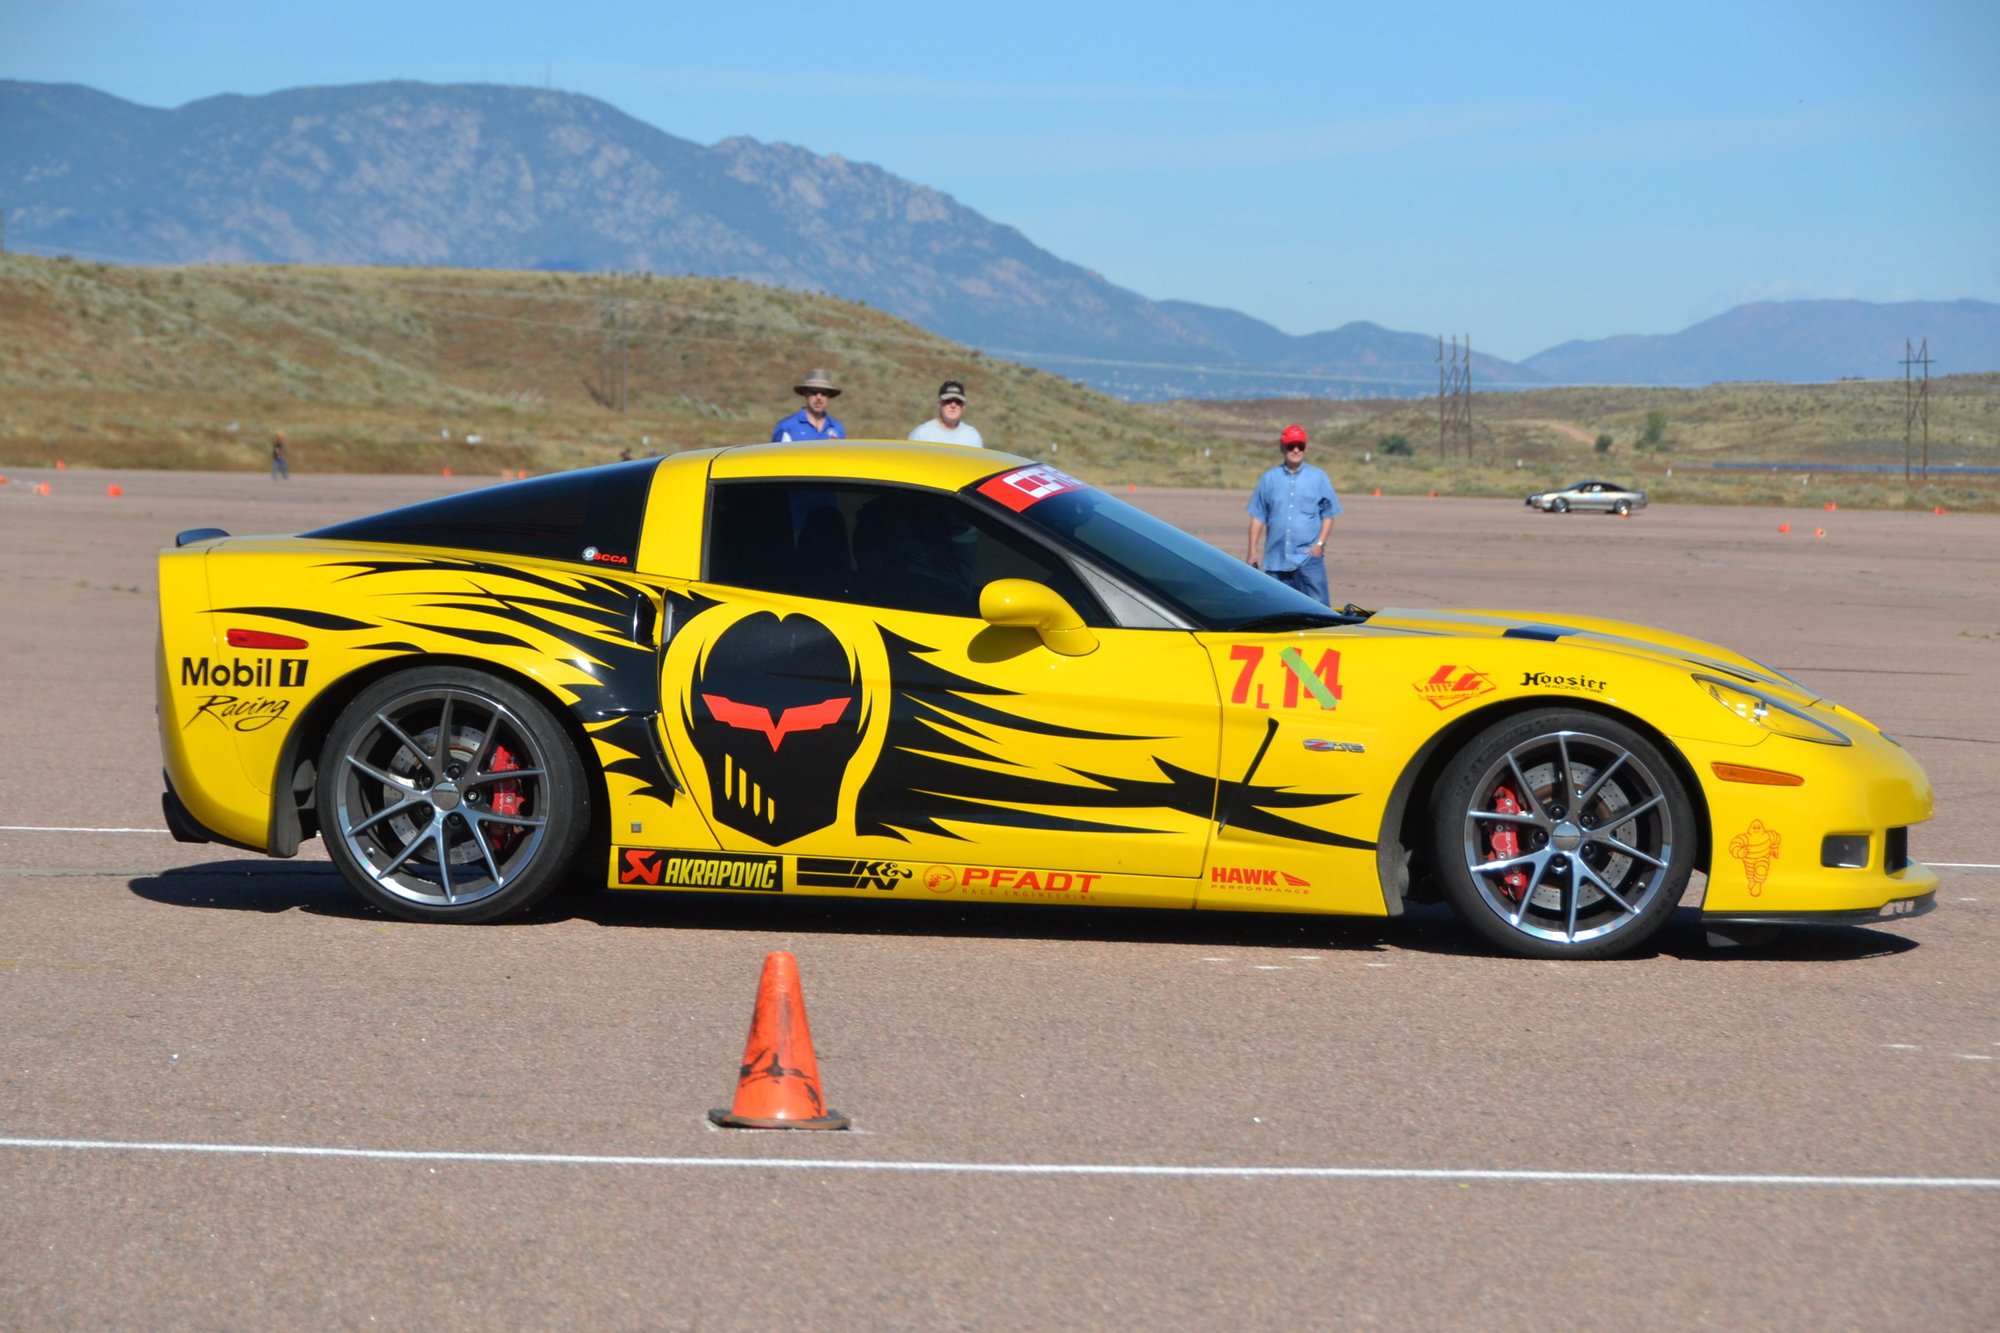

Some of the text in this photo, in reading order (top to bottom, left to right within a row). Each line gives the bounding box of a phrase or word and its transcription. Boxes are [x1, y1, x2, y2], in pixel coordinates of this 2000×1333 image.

[594, 552, 628, 564] SCCA
[181, 657, 272, 687] Mobil
[1519, 671, 1607, 690] Hoosier
[182, 694, 290, 732] Racing
[961, 867, 1102, 893] PFADT
[1211, 866, 1279, 886] HAWK
[1211, 884, 1310, 895] PERFORMANCE
